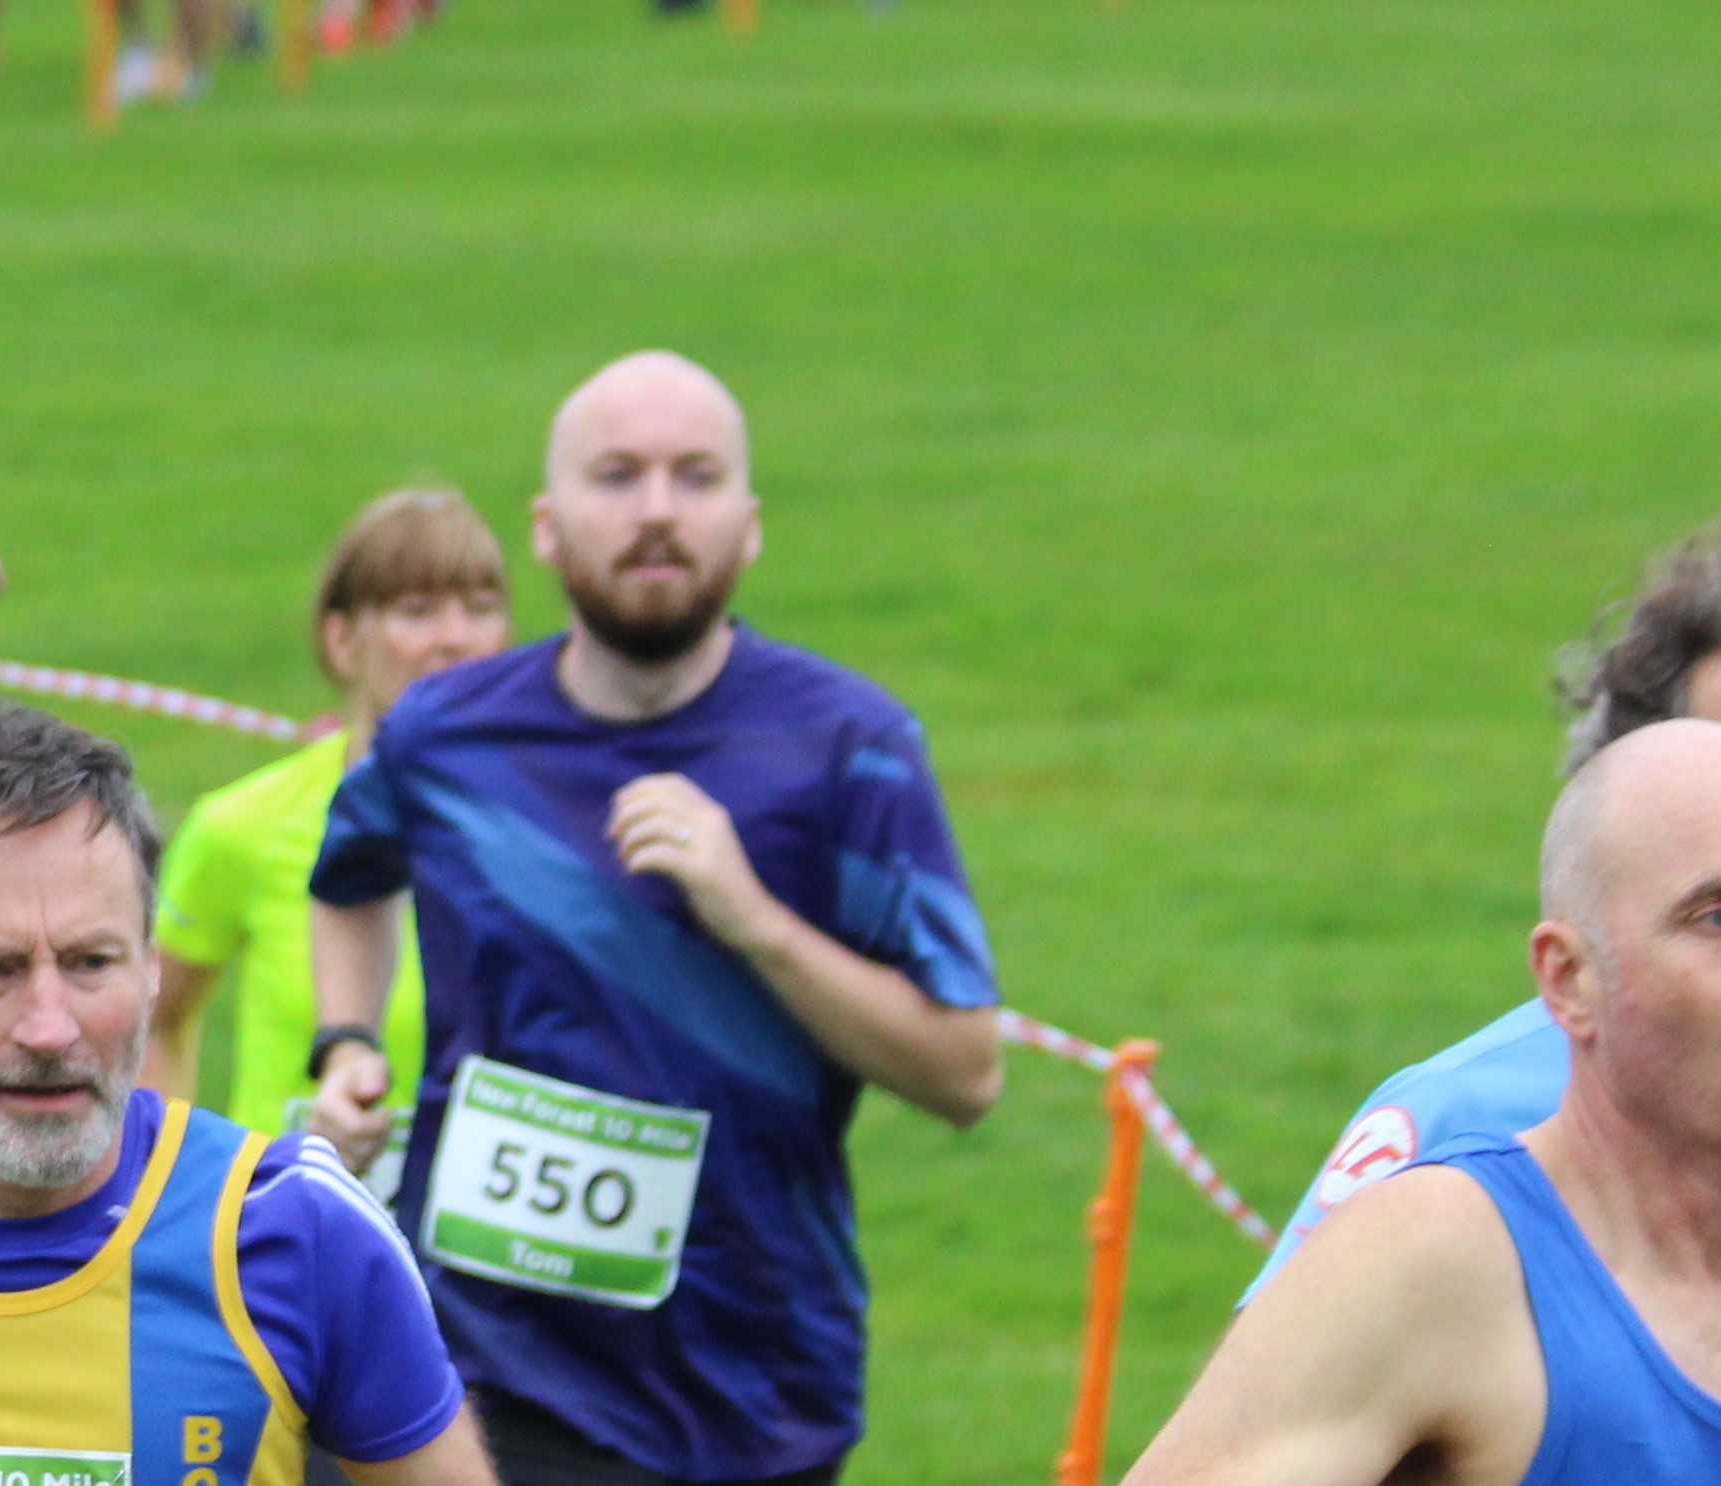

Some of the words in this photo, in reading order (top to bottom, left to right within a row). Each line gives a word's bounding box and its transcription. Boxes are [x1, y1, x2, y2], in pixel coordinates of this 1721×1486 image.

[602, 1114, 635, 1143] 10
[482, 1140, 637, 1230] 550
[508, 1238, 575, 1279] Tom
